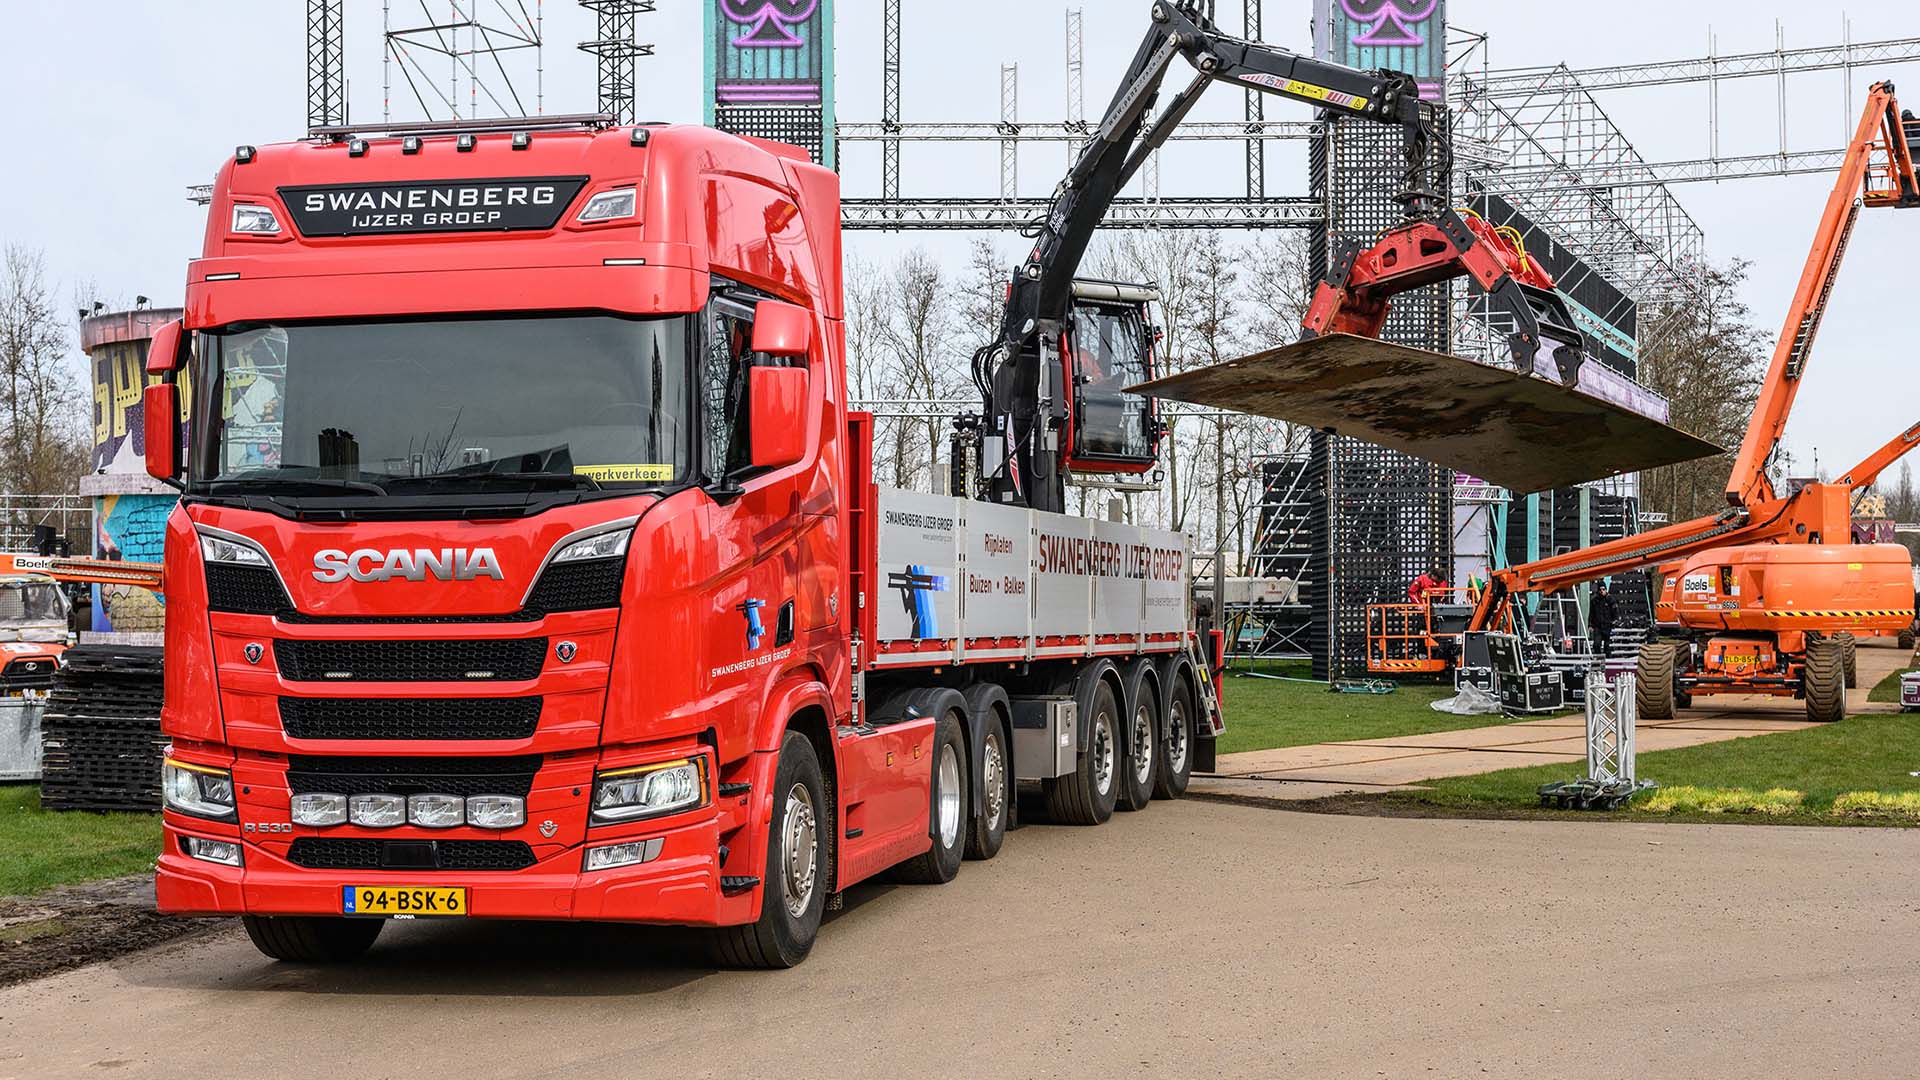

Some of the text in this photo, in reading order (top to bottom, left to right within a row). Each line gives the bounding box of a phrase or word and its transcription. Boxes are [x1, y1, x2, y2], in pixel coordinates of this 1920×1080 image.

[304, 186, 555, 212] SWANENBERG
[352, 211, 501, 228] IJZER GROEP
[885, 510, 922, 528] SWANENBERG
[937, 517, 953, 531] GROEP
[984, 533, 1013, 557] Rijplaten
[311, 547, 504, 583] SCANIA
[1039, 534, 1182, 581] SWANENBERG IJZER GROEP
[969, 574, 1025, 595] Buizen Balken
[1684, 579, 1707, 591] Boels
[712, 658, 755, 678] SWANENBERG
[773, 648, 791, 661] GROEP
[244, 822, 292, 833] R 530
[362, 890, 459, 911] 94-BSK-6
